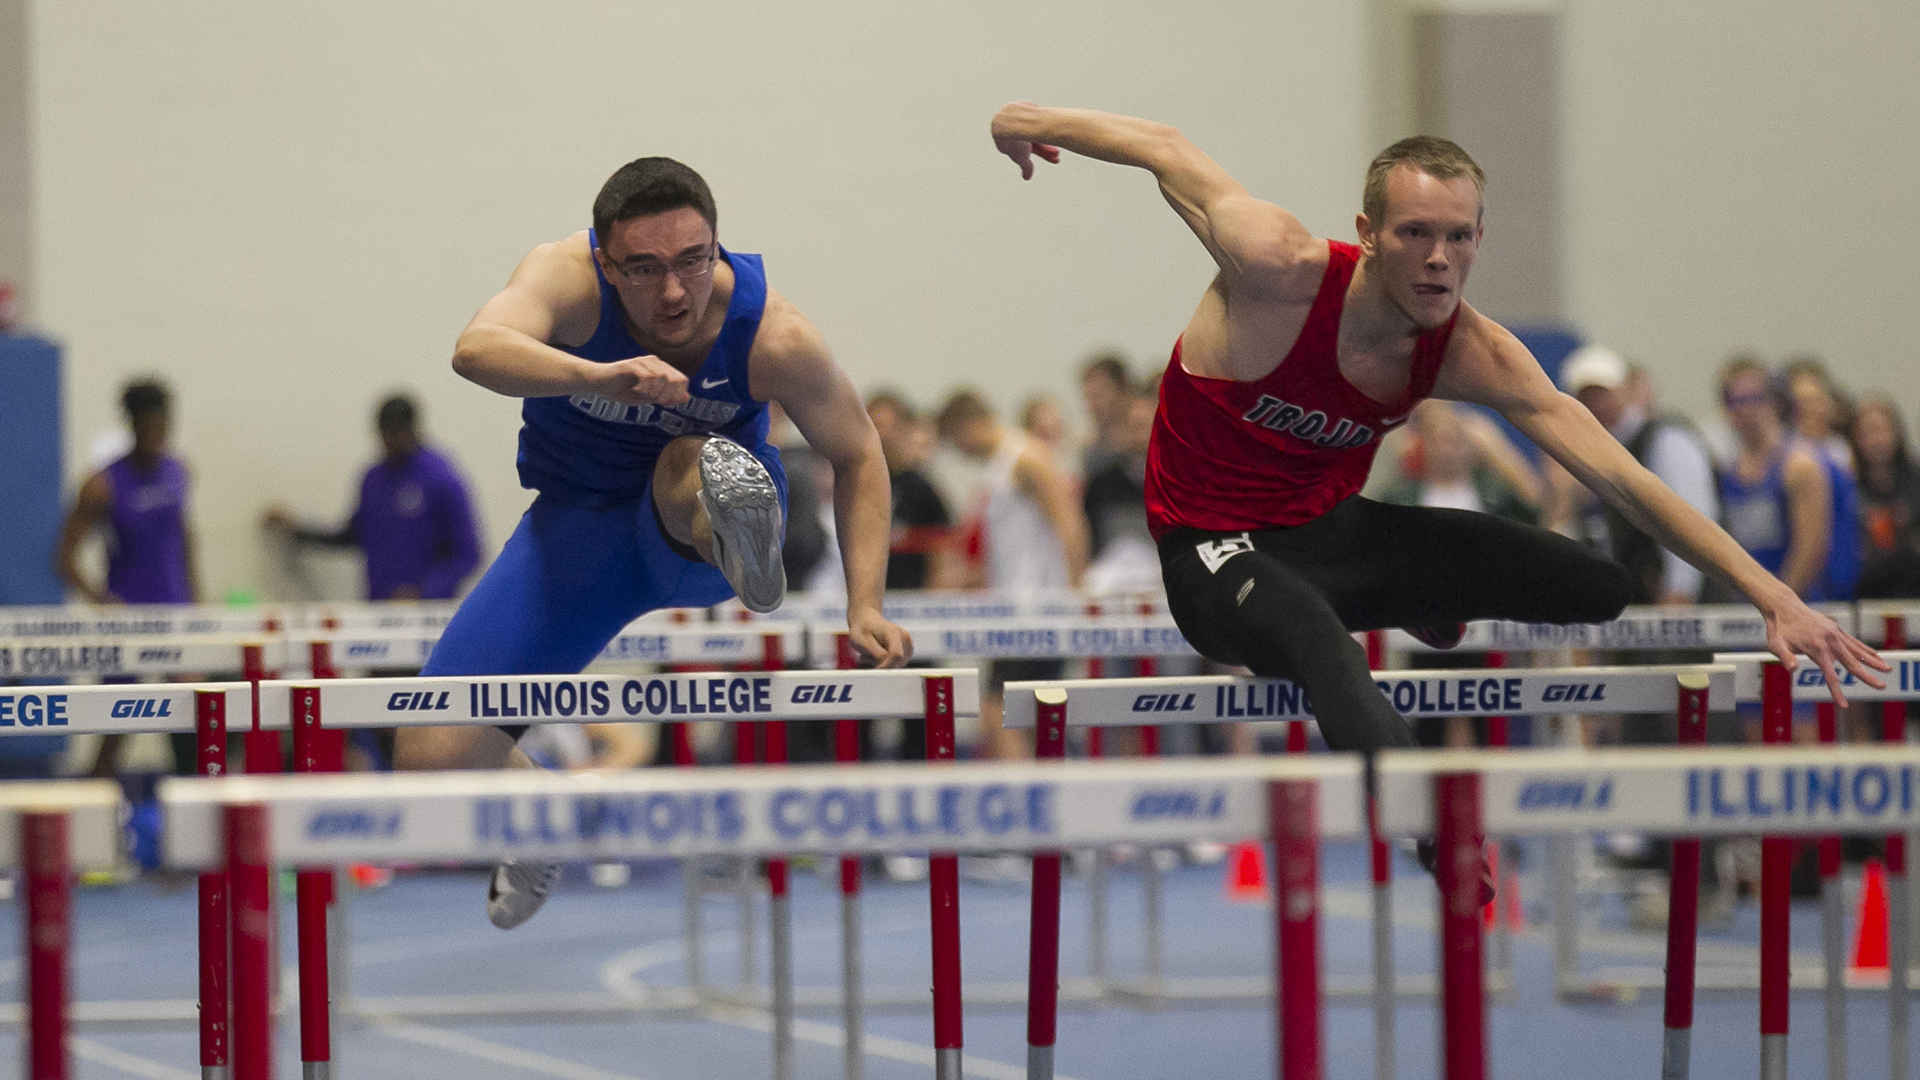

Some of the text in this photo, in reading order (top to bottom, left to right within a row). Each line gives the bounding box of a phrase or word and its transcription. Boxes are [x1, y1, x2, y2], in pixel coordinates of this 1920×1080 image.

[111, 698, 172, 719] GILL
[386, 678, 853, 718] GILL ILLINOIS COLLEGE GILL
[1132, 693, 1198, 712] GILL
[1541, 684, 1607, 702] GILL
[475, 792, 745, 844] ILLINOIS
[769, 780, 1056, 838] COLLEGE
